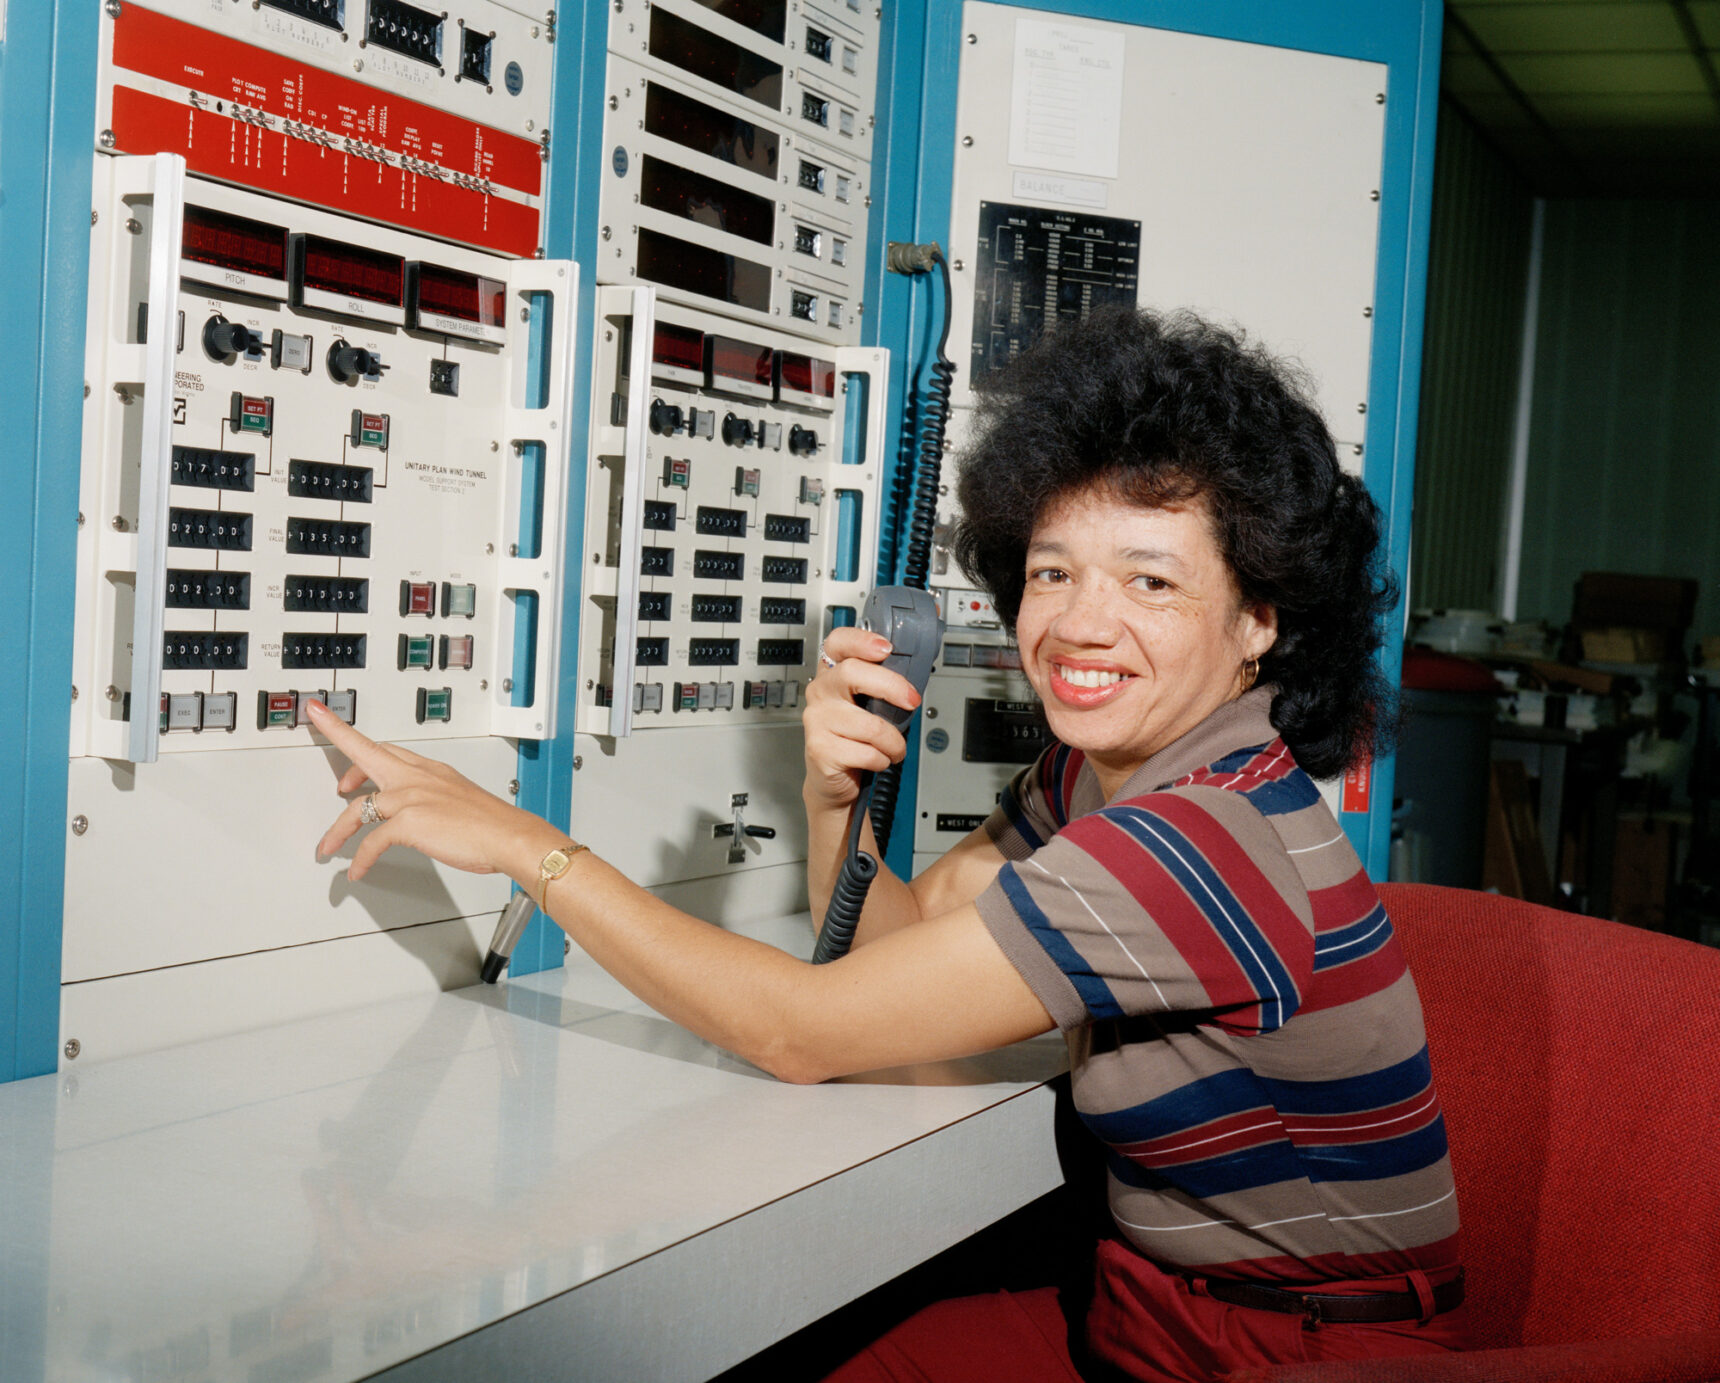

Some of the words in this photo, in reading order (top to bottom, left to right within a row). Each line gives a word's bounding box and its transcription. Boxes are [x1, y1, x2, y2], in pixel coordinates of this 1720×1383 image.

[184, 65, 204, 77] EXECUTE
[232, 77, 244, 86] PLOT
[245, 81, 266, 93] COMPUTE
[1019, 179, 1065, 196] BALANCE
[225, 272, 246, 285] PITCH
[207, 300, 222, 309] RATE
[348, 301, 364, 314] ROLL
[246, 319, 260, 327] INCR
[331, 325, 344, 333] RATE
[435, 318, 458, 331] SYSTEM
[458, 322, 488, 337] PARAMET
[288, 348, 302, 356] ZERO
[405, 461, 430, 473] UNITARY
[431, 465, 447, 474] PLAN
[449, 467, 464, 477] WIND
[466, 469, 488, 480] TUNNEL
[418, 475, 435, 483] MODEL
[436, 477, 457, 486] SUPPORT
[458, 479, 477, 488] SYSTEM
[428, 484, 441, 492] TEST
[441, 486, 461, 495] SECTION
[171, 522, 237, 536] 020.00
[288, 531, 357, 545] +135.00
[169, 583, 235, 597] 002.00
[166, 645, 232, 657] 000.00
[261, 643, 281, 651] RETURN
[209, 708, 225, 716] ENTER
[947, 819, 965, 827] WEST
